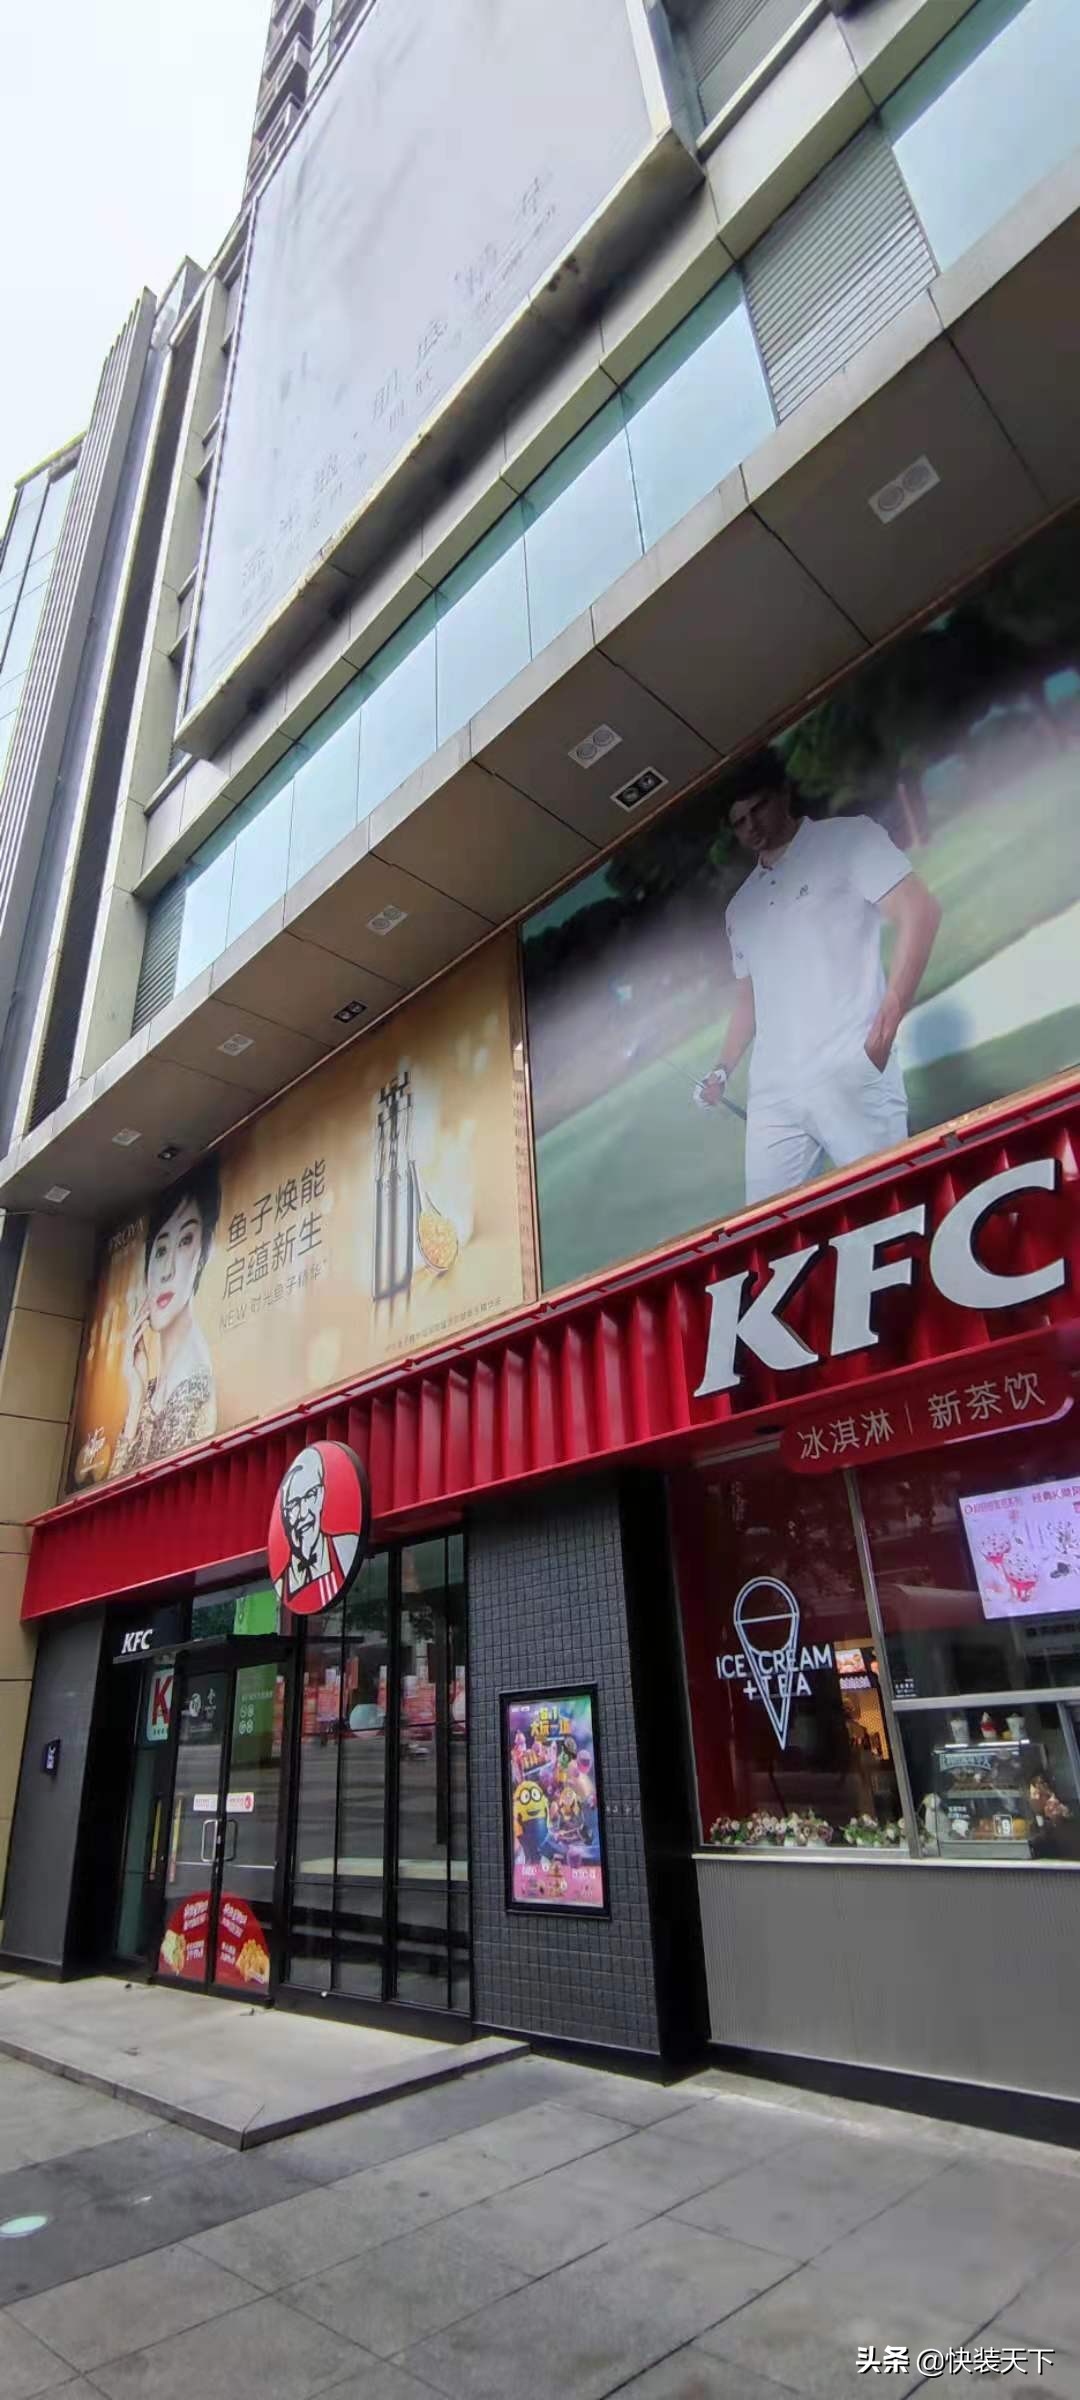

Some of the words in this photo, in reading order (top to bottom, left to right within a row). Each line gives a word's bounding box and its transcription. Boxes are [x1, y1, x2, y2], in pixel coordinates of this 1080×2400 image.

[226, 1160, 326, 1252] 鱼子焕能
[222, 1211, 322, 1300] 启蕴新生
[694, 1158, 1065, 1399] KFC
[797, 1408, 895, 1460] 冰淇淋
[927, 1372, 1046, 1430] 新茶饮
[121, 1629, 153, 1654] KFC
[716, 1654, 747, 1679] ICE
[758, 1643, 832, 1674] CREAM
